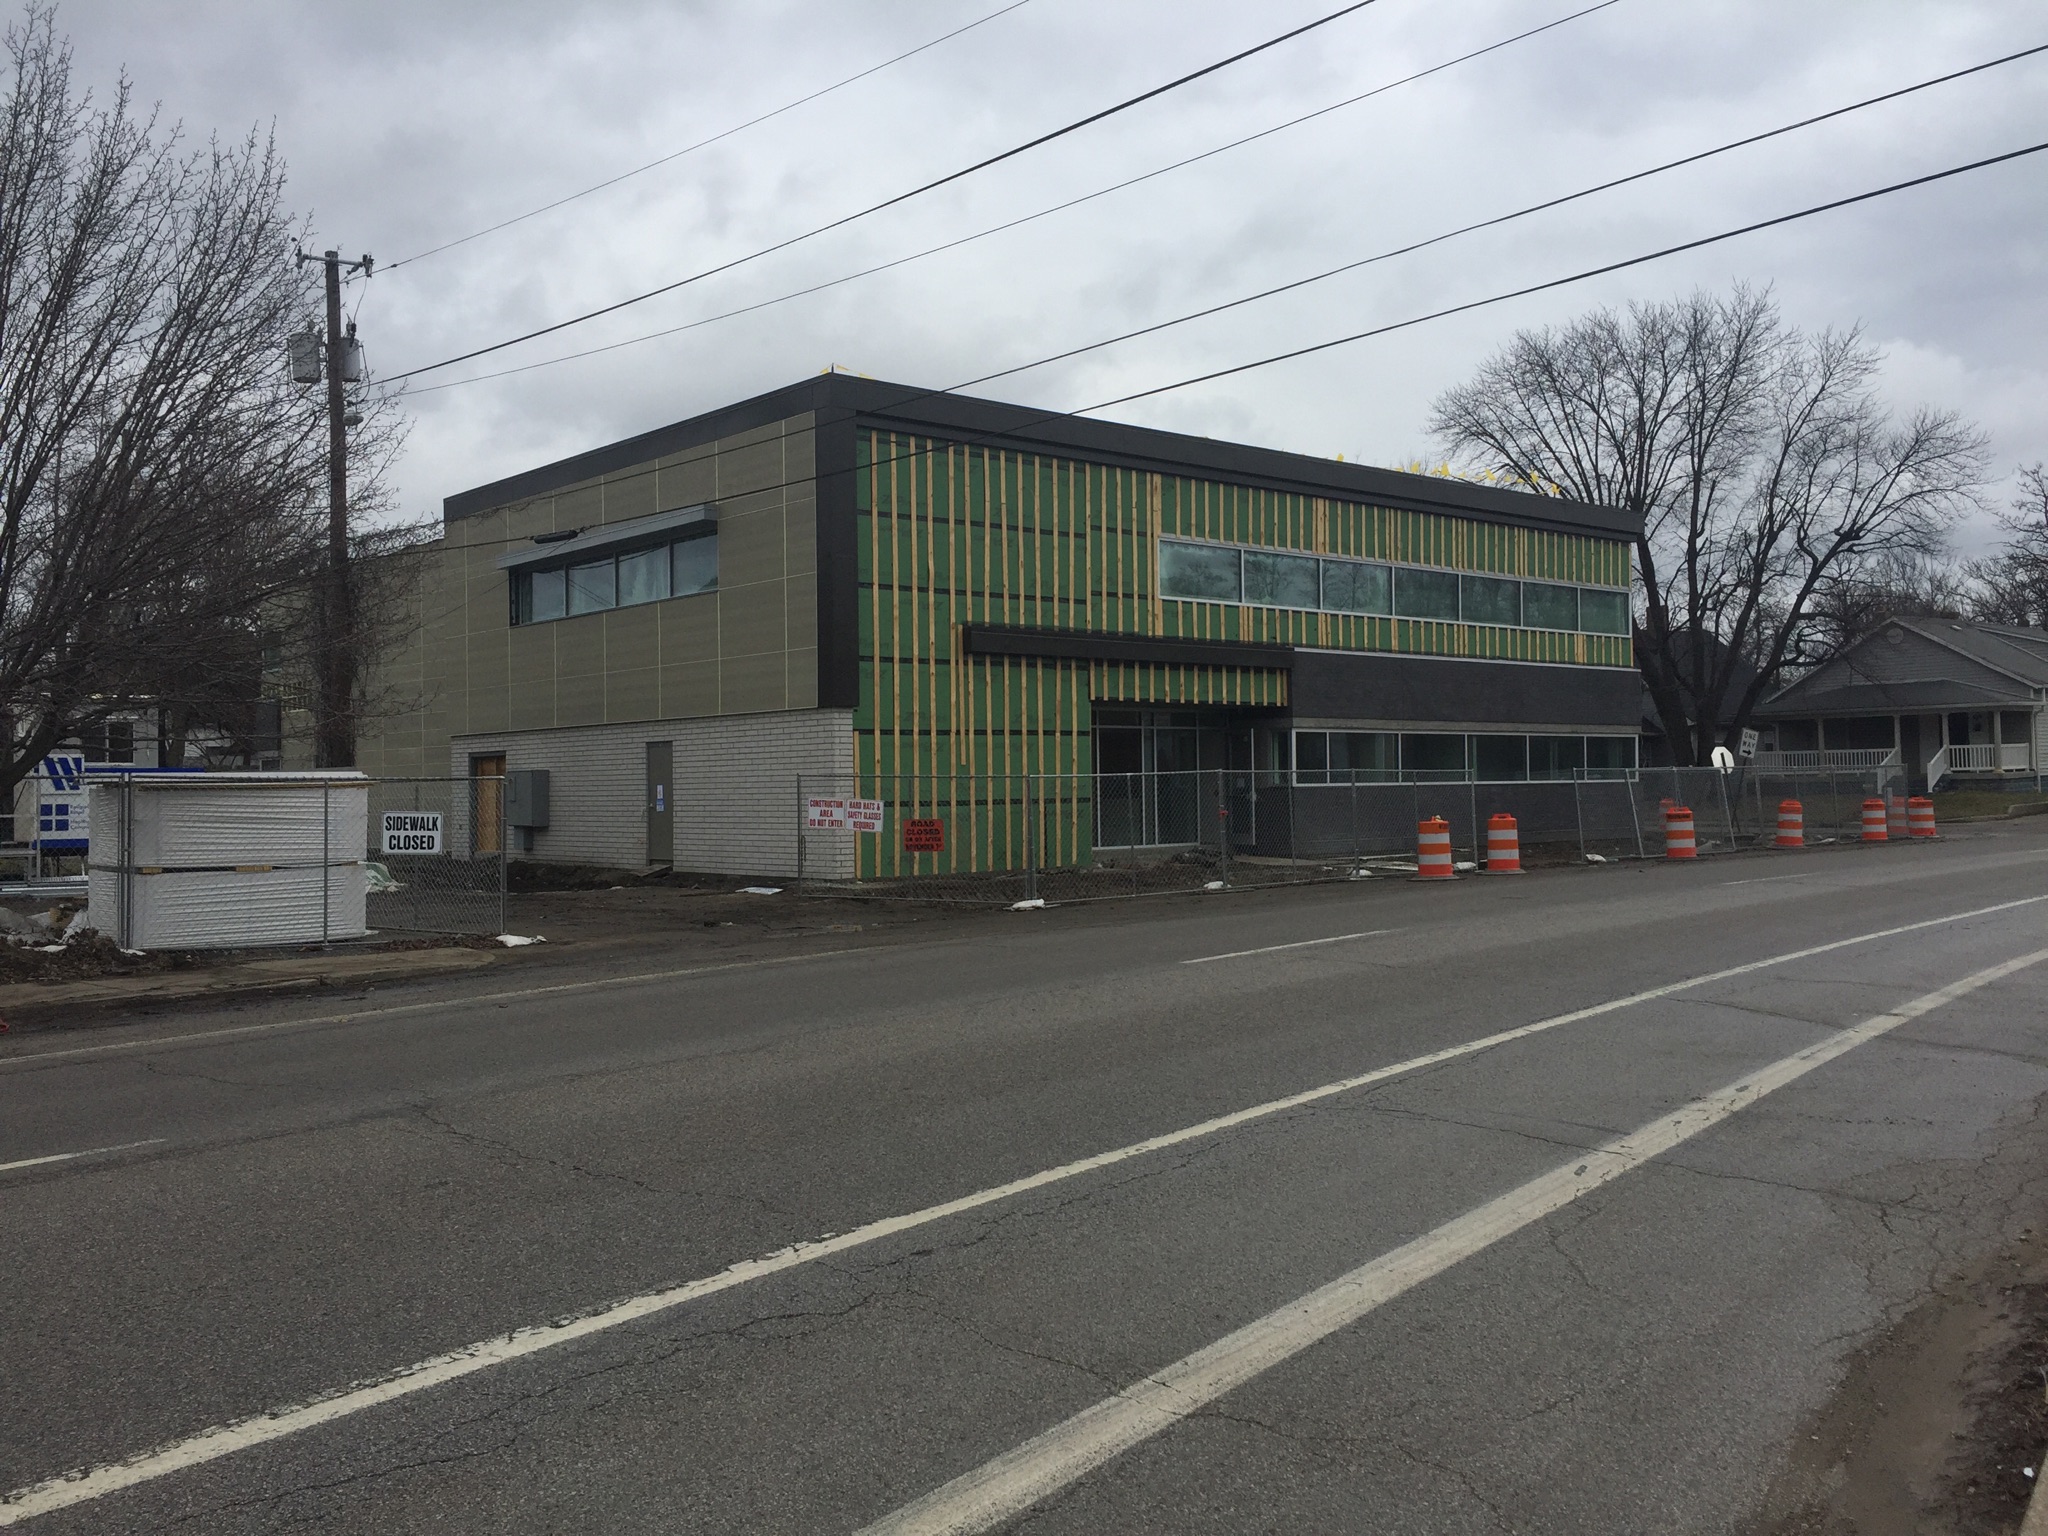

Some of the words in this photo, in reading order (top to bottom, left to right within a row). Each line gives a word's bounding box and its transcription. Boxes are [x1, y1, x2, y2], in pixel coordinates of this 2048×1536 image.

[1744, 732, 1756, 740] ONE
[809, 800, 843, 808] CONSTRUCTION
[849, 801, 861, 809] HARD
[863, 801, 875, 810] HATS
[819, 809, 833, 817] AREA
[847, 811, 862, 819] SAFETY
[863, 812, 881, 820] GLASSES
[385, 816, 439, 831] SIDEWALK
[809, 818, 816, 827] DO
[817, 819, 826, 827] NOT
[828, 819, 843, 827] ENTER
[853, 821, 875, 830] REQUIRED
[906, 828, 940, 836] CLOSED
[389, 835, 435, 850] CLOSED
